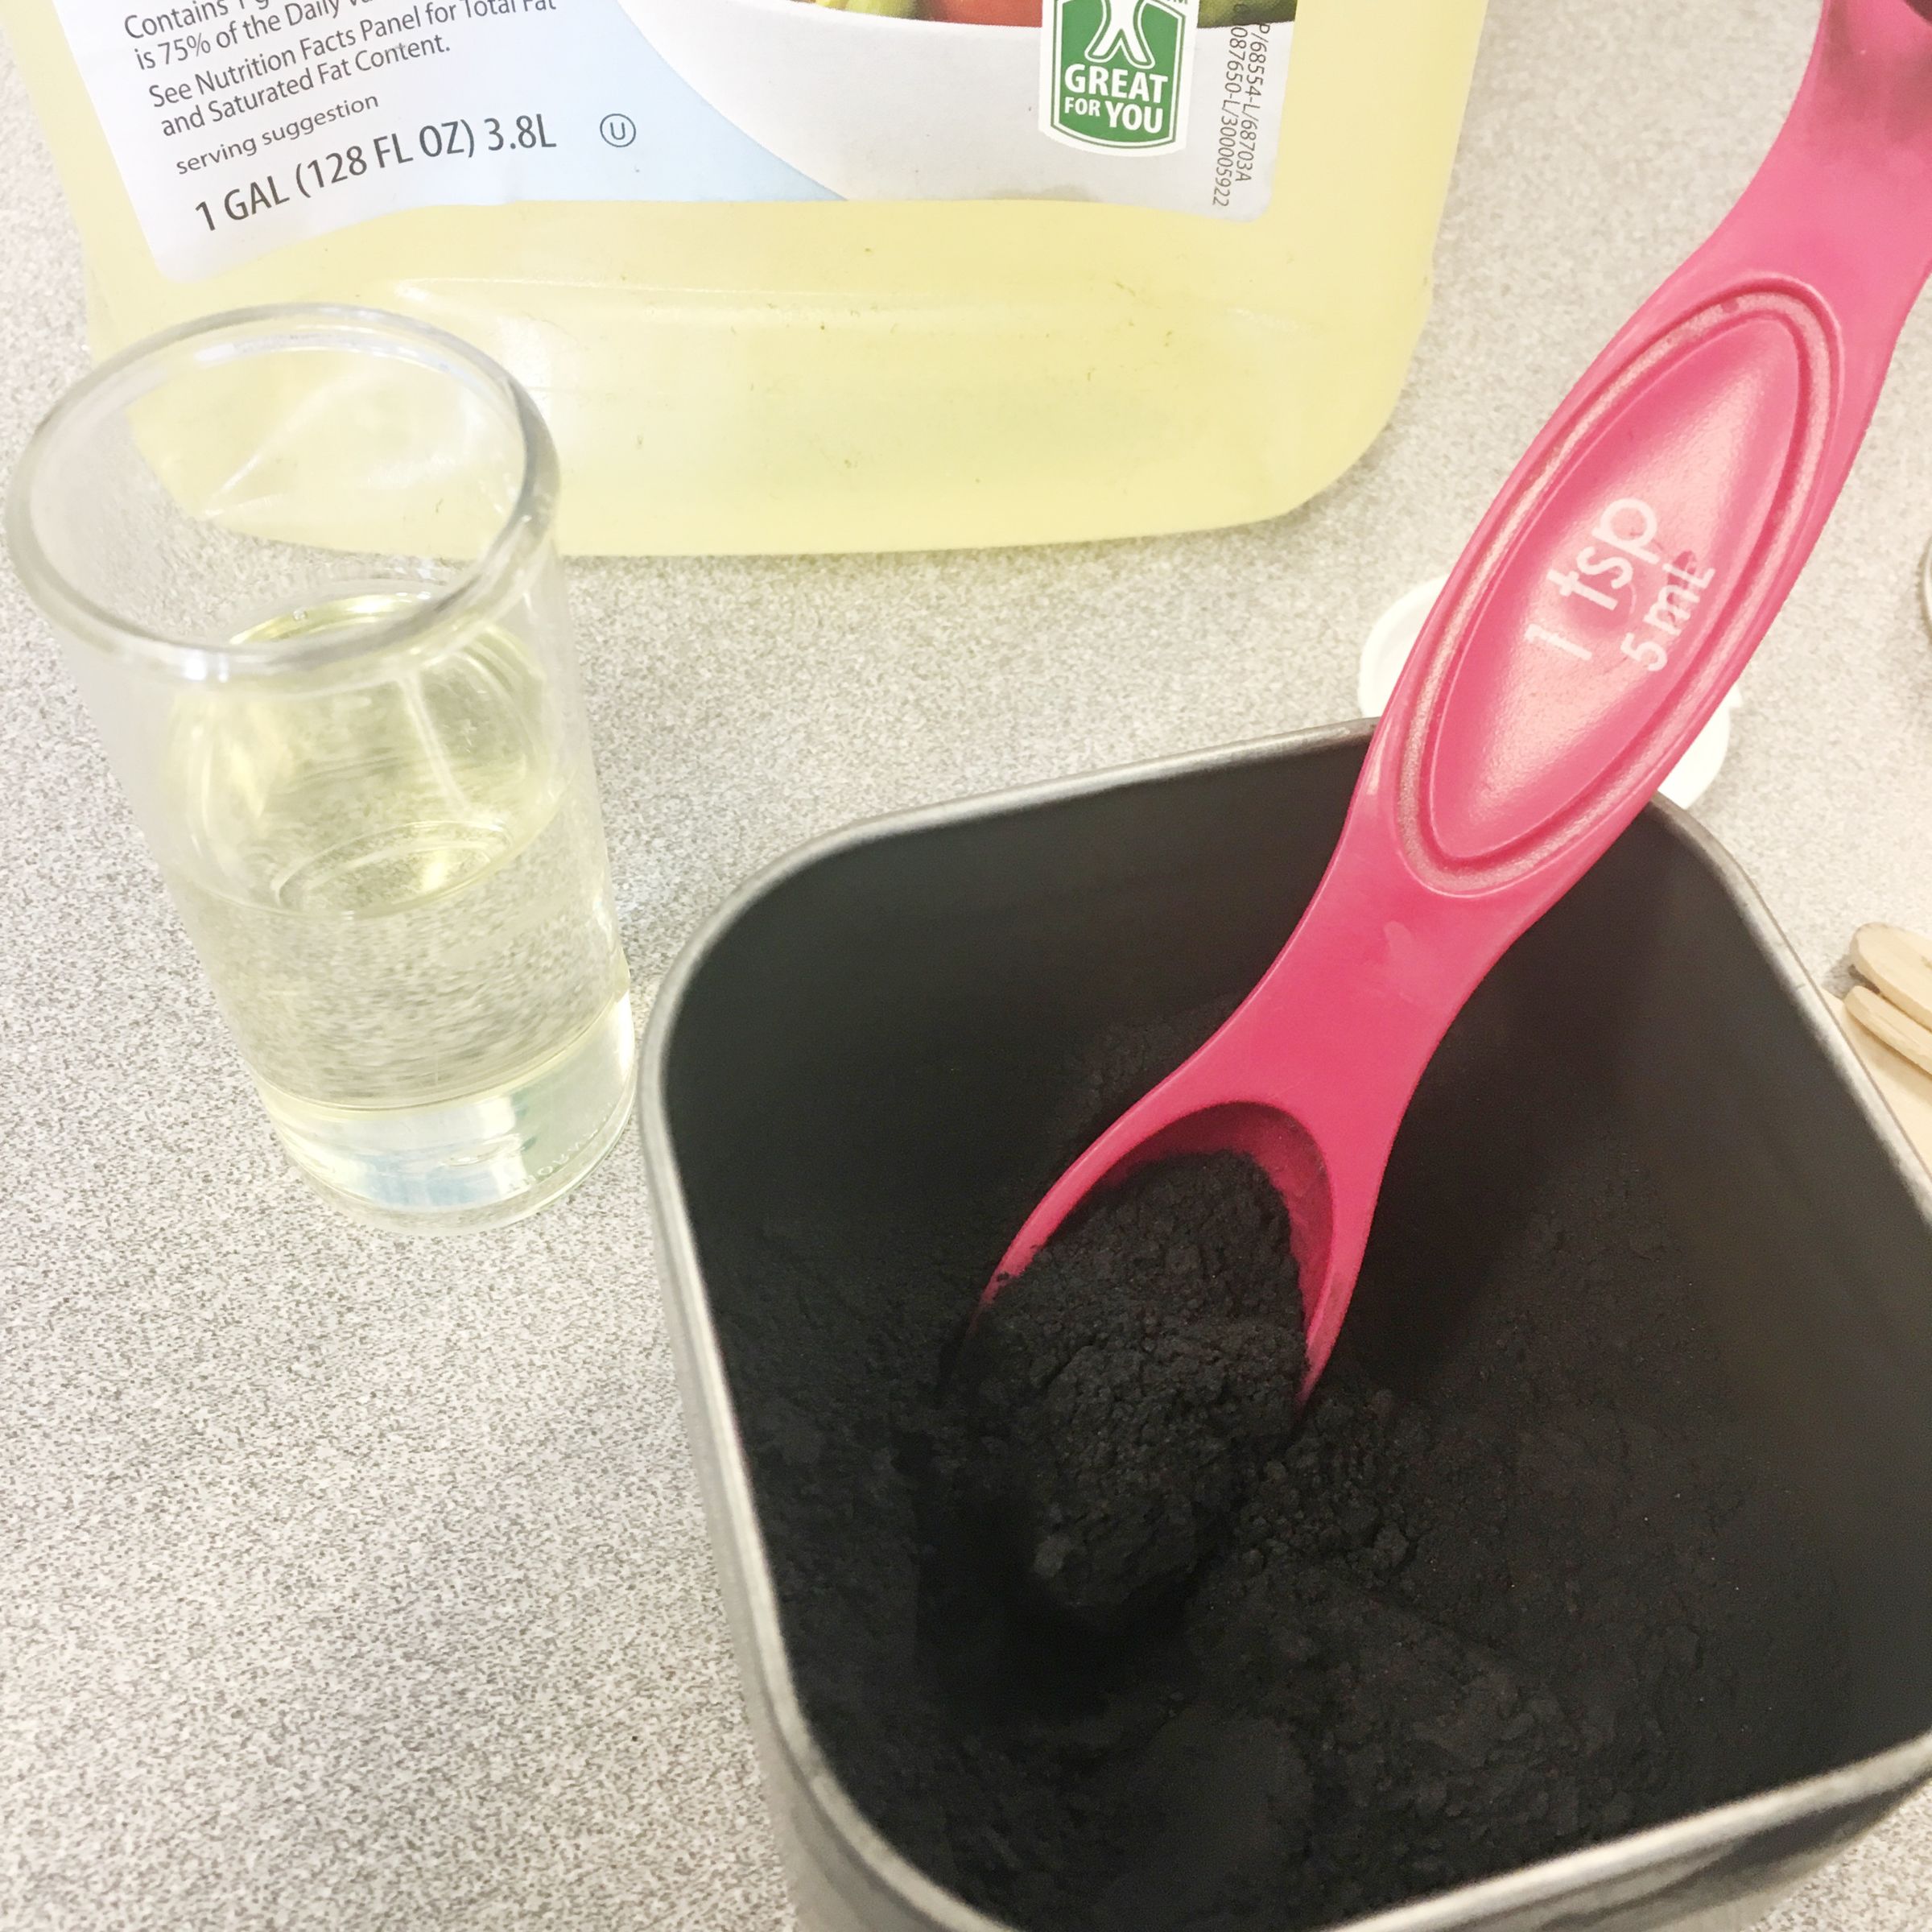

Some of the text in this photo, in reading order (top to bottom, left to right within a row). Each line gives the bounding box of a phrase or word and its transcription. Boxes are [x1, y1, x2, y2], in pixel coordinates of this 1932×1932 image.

[124, 0, 229, 39] Contains
[134, 48, 156, 70] is
[158, 32, 211, 65] 75%
[216, 20, 238, 48] of
[242, 14, 282, 39] the
[149, 83, 193, 107] See
[195, 49, 296, 95] Nutrition
[299, 29, 356, 60] Facts
[360, 6, 421, 41] Panel
[425, 2, 456, 25] for
[161, 35, 451, 136] and Saturated Fat Content.
[1064, 63, 1168, 104] GREAT
[1064, 96, 1163, 134] FOR YOU
[176, 95, 379, 175] serving suggestion
[195, 114, 557, 231] 1 GAL (128 FL OZ) 3.8L
[1524, 497, 1660, 661] 1 tsp
[1620, 563, 1715, 671] 5 mL
